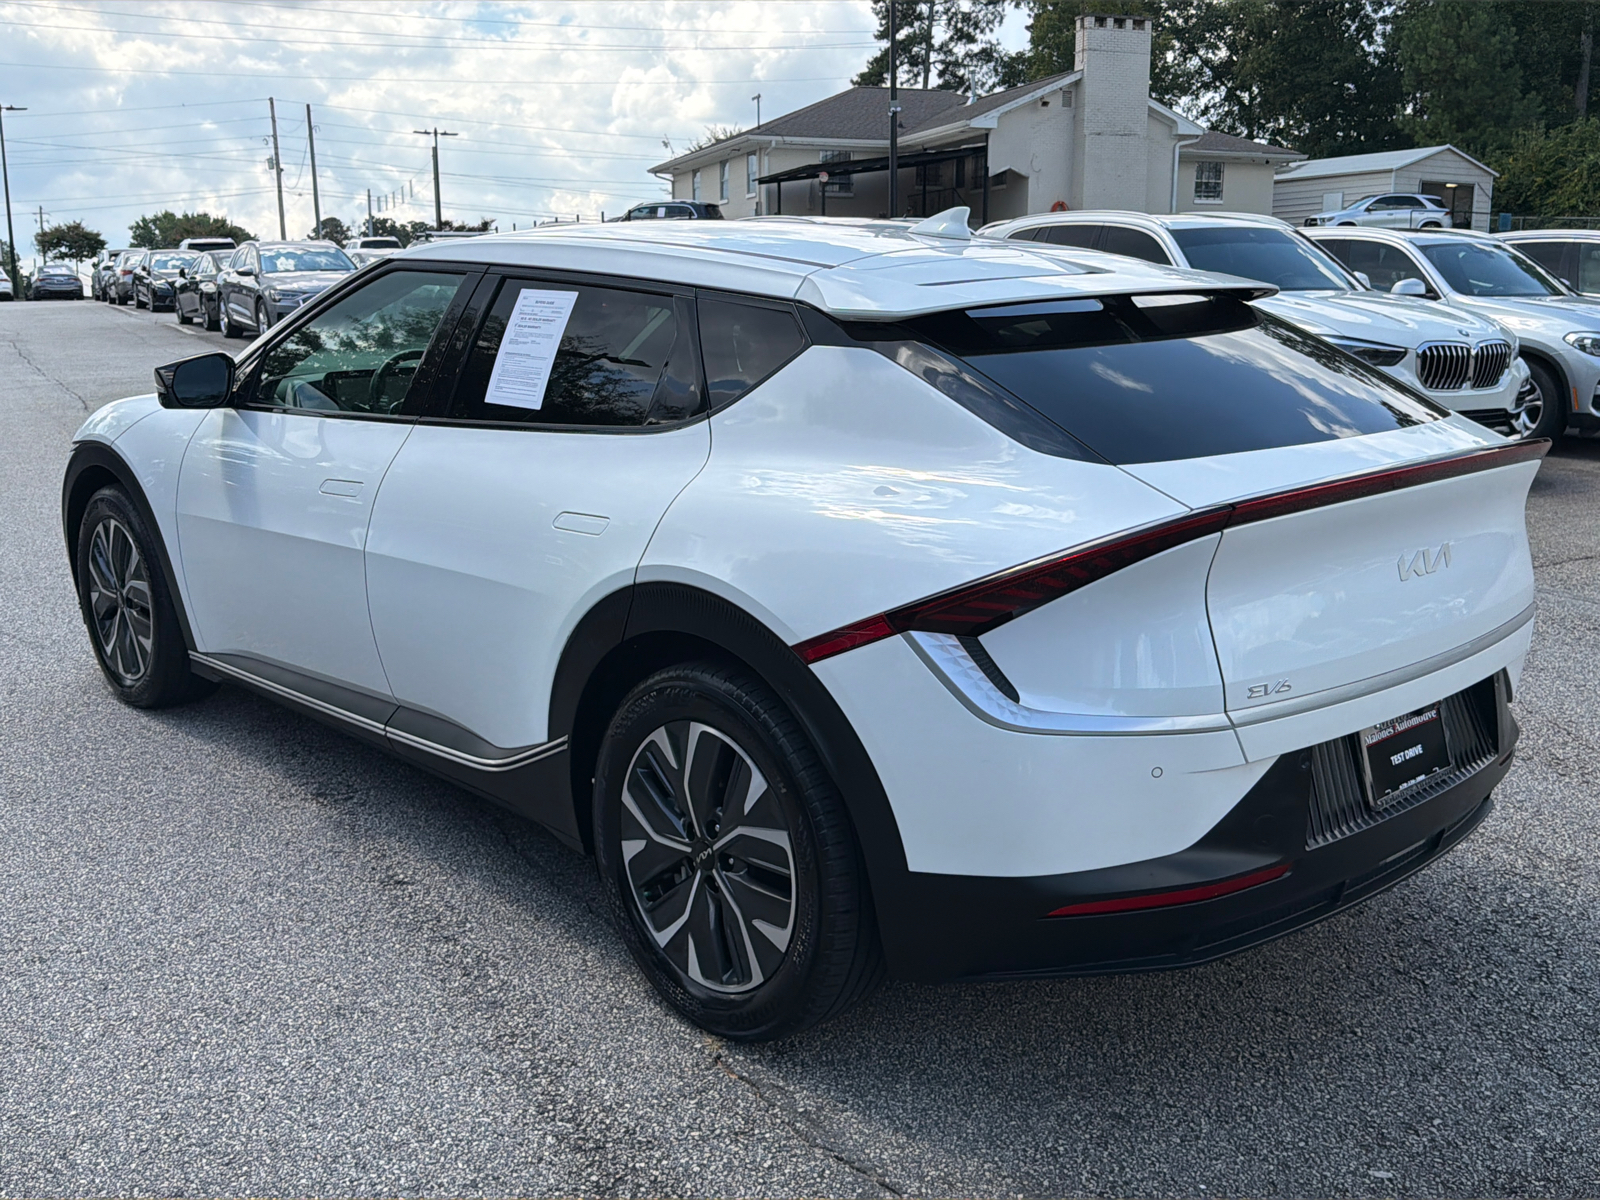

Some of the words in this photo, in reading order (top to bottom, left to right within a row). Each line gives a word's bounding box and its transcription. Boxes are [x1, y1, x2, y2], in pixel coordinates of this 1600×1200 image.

[1397, 543, 1451, 582] KIA
[1247, 678, 1292, 699] EV6
[1390, 753, 1405, 766] TEST
[1405, 744, 1424, 760] DRIVE
